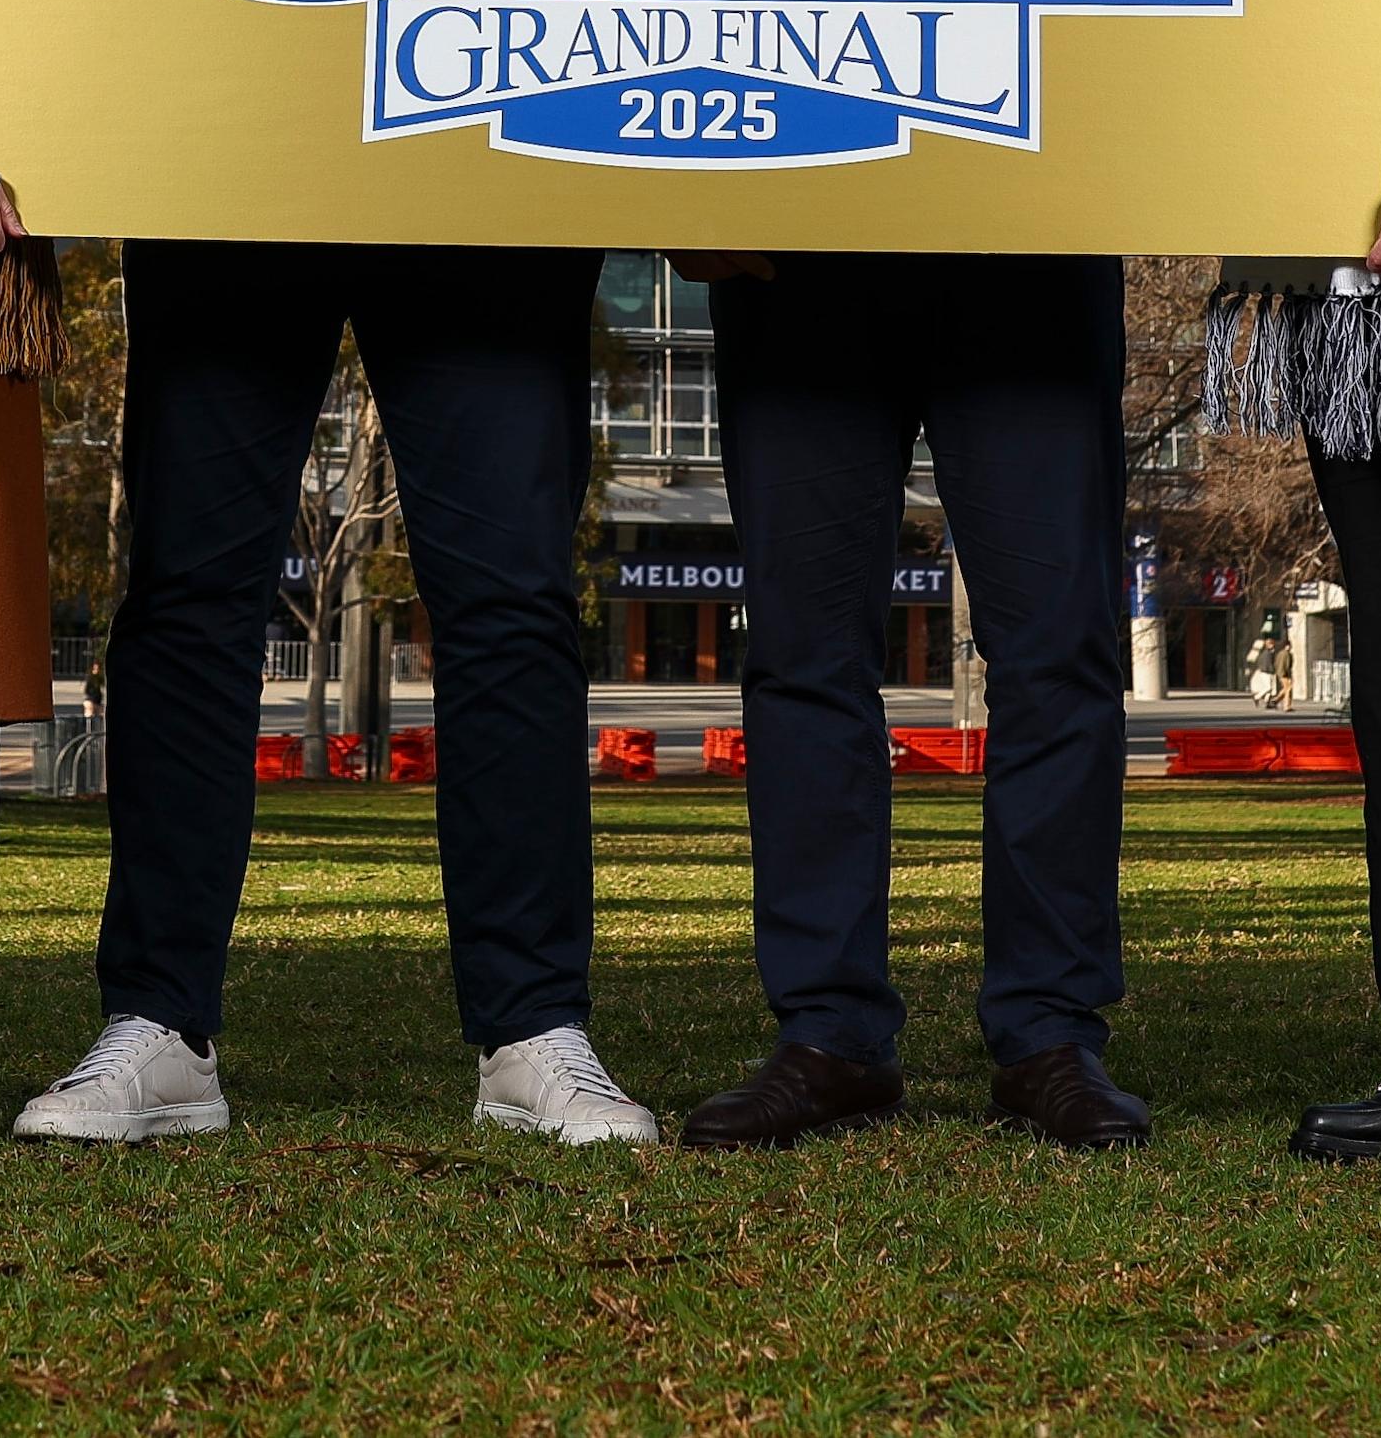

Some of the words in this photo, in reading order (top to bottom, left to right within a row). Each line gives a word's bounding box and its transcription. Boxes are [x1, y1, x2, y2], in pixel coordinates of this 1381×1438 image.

[396, 6, 693, 102] GRAND
[711, 8, 1010, 115] FINAL
[618, 88, 778, 141] 2025
[620, 565, 744, 589] MELBOU
[891, 570, 945, 592] KET
